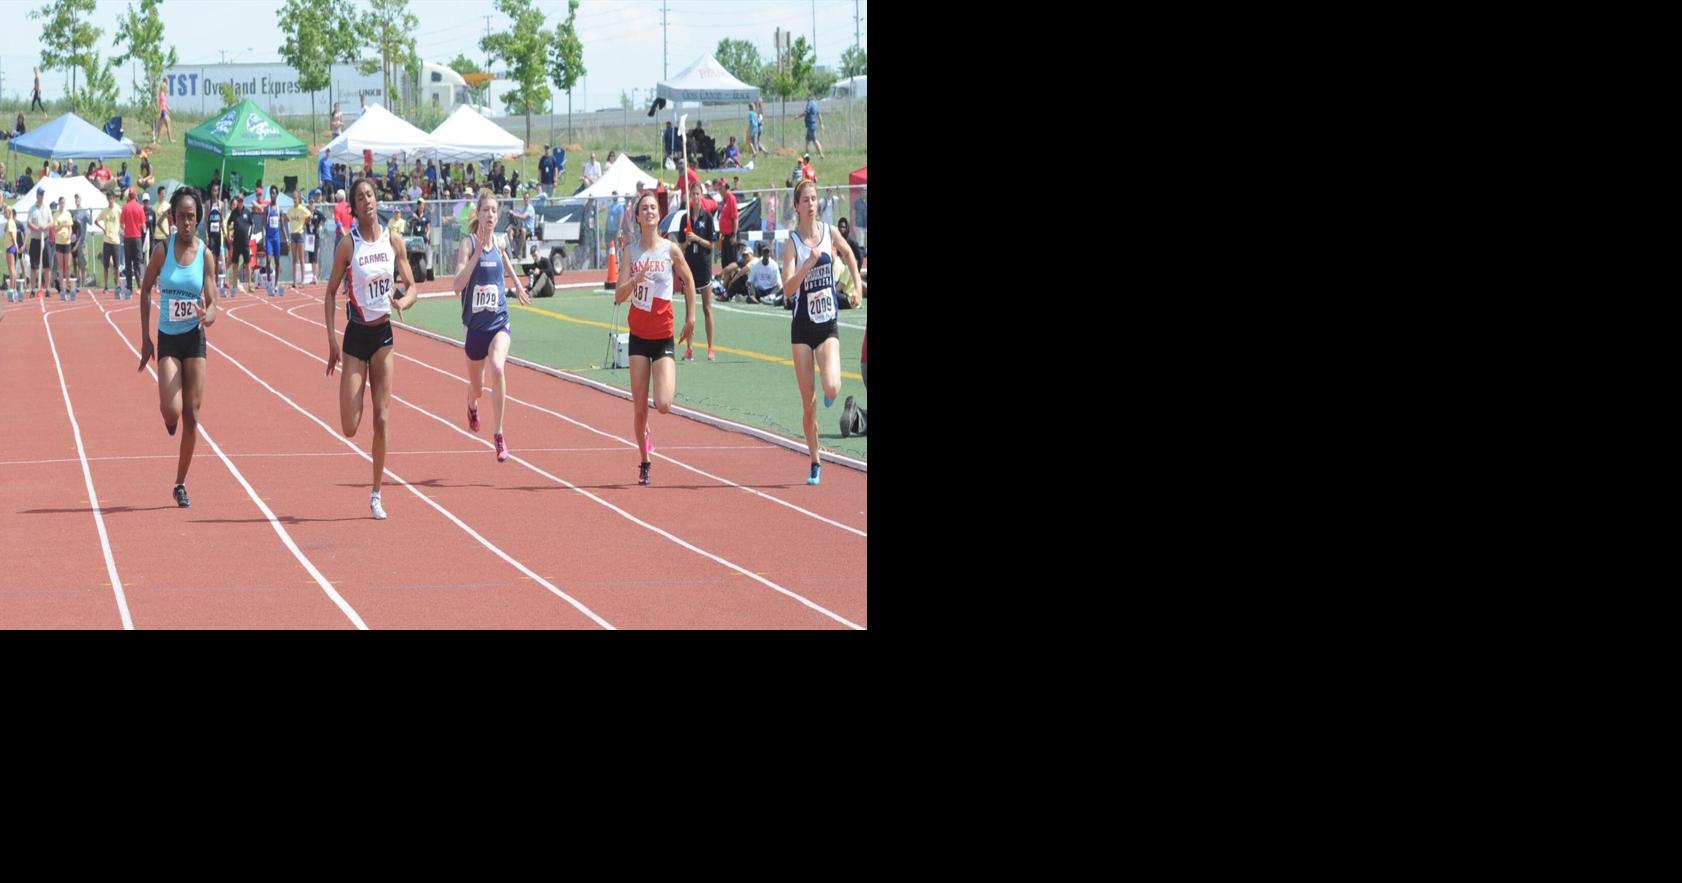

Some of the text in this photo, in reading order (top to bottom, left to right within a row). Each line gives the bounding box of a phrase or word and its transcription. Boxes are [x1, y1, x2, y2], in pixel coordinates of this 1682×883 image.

[167, 73, 303, 98] TST Oveland Expres
[359, 252, 389, 266] CARMEL
[630, 260, 666, 274] RANERS
[368, 278, 390, 299] 1762
[476, 292, 497, 307] 1029
[810, 296, 832, 315] 2009
[174, 301, 193, 317] 292
